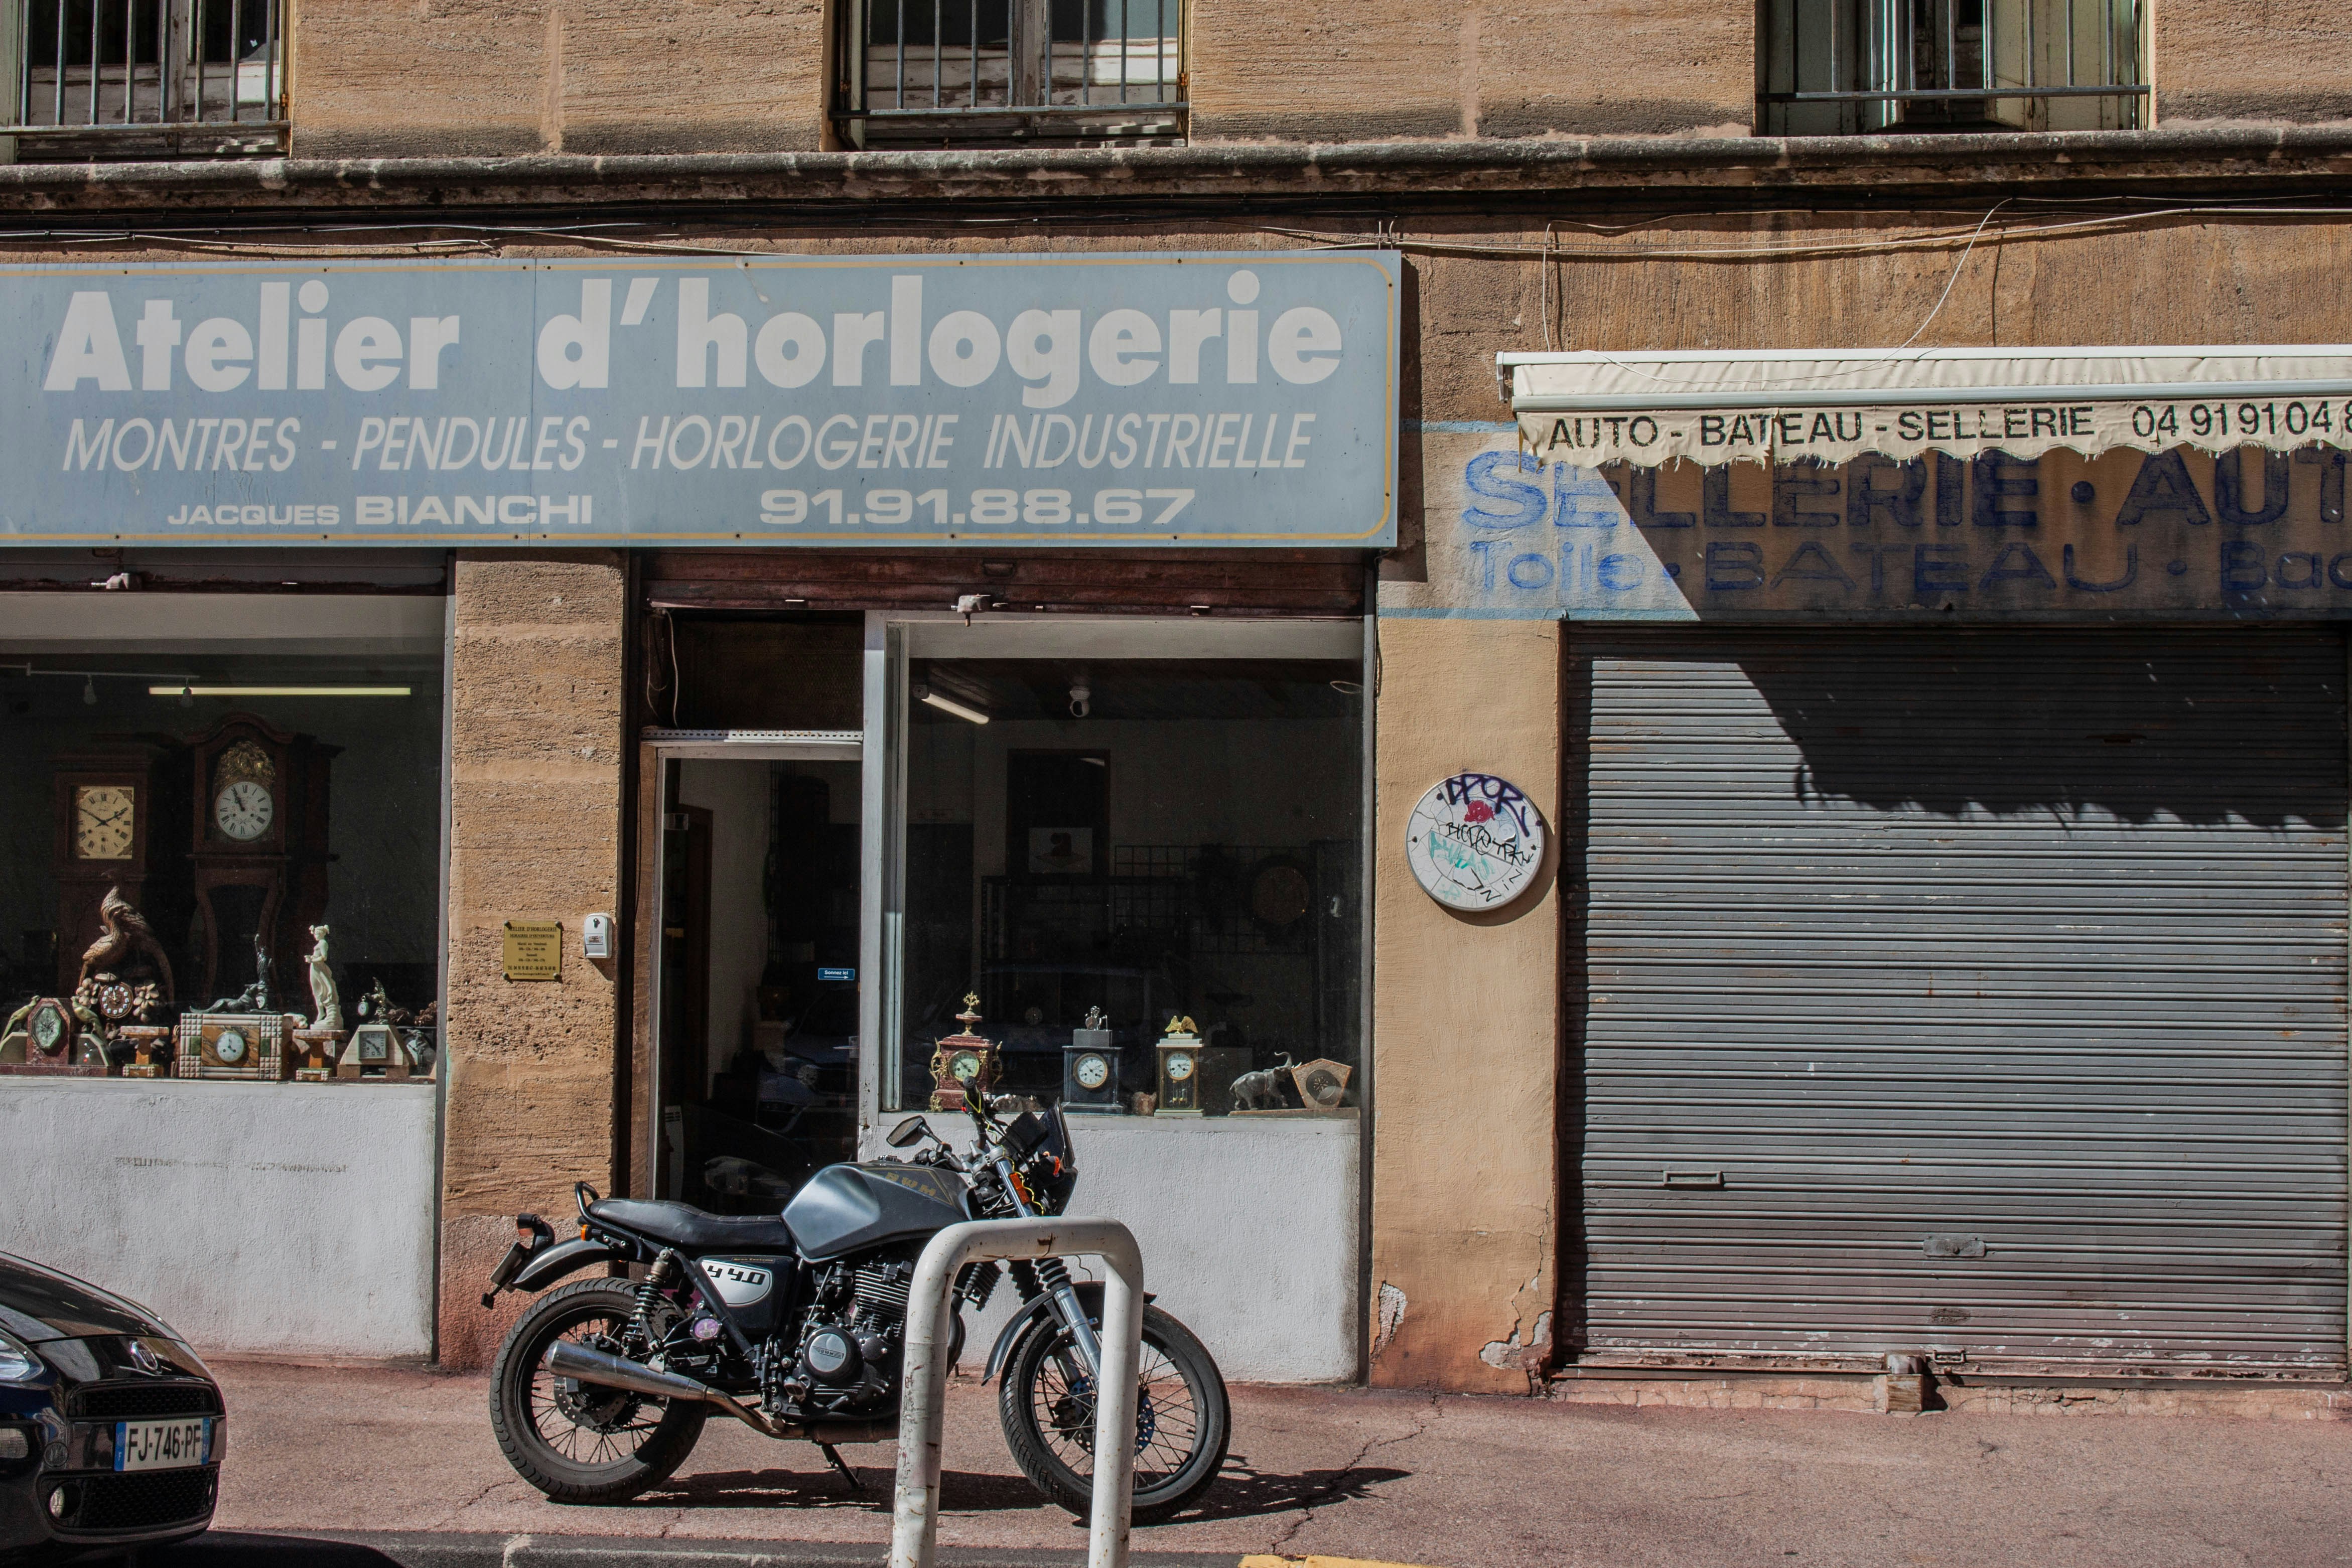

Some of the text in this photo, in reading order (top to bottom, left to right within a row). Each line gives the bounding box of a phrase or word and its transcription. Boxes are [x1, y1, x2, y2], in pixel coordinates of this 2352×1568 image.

[44, 269, 1342, 408] Atelier d'horlogerie
[63, 417, 301, 471] MONTRES
[352, 415, 590, 471] PENDULES
[631, 413, 959, 470] HORLOGERIE
[984, 412, 1316, 469] INDUSTRIELLE
[1549, 416, 1658, 451] AUTO
[1701, 412, 1862, 446] BATEAU
[1897, 405, 2095, 442] SELLERIE
[2132, 404, 2179, 438] 04
[2190, 403, 2228, 436] 91
[2238, 402, 2276, 436] 91
[2285, 401, 2332, 436] 04
[168, 495, 592, 525] JACQUES BIANCHI
[760, 489, 1195, 524] 91.91.88.67
[1462, 451, 2039, 529] SELLERIE
[1470, 541, 1644, 591] Toile
[1709, 541, 2137, 592] BATEAU
[127, 1424, 201, 1462] FJ-746-PF
